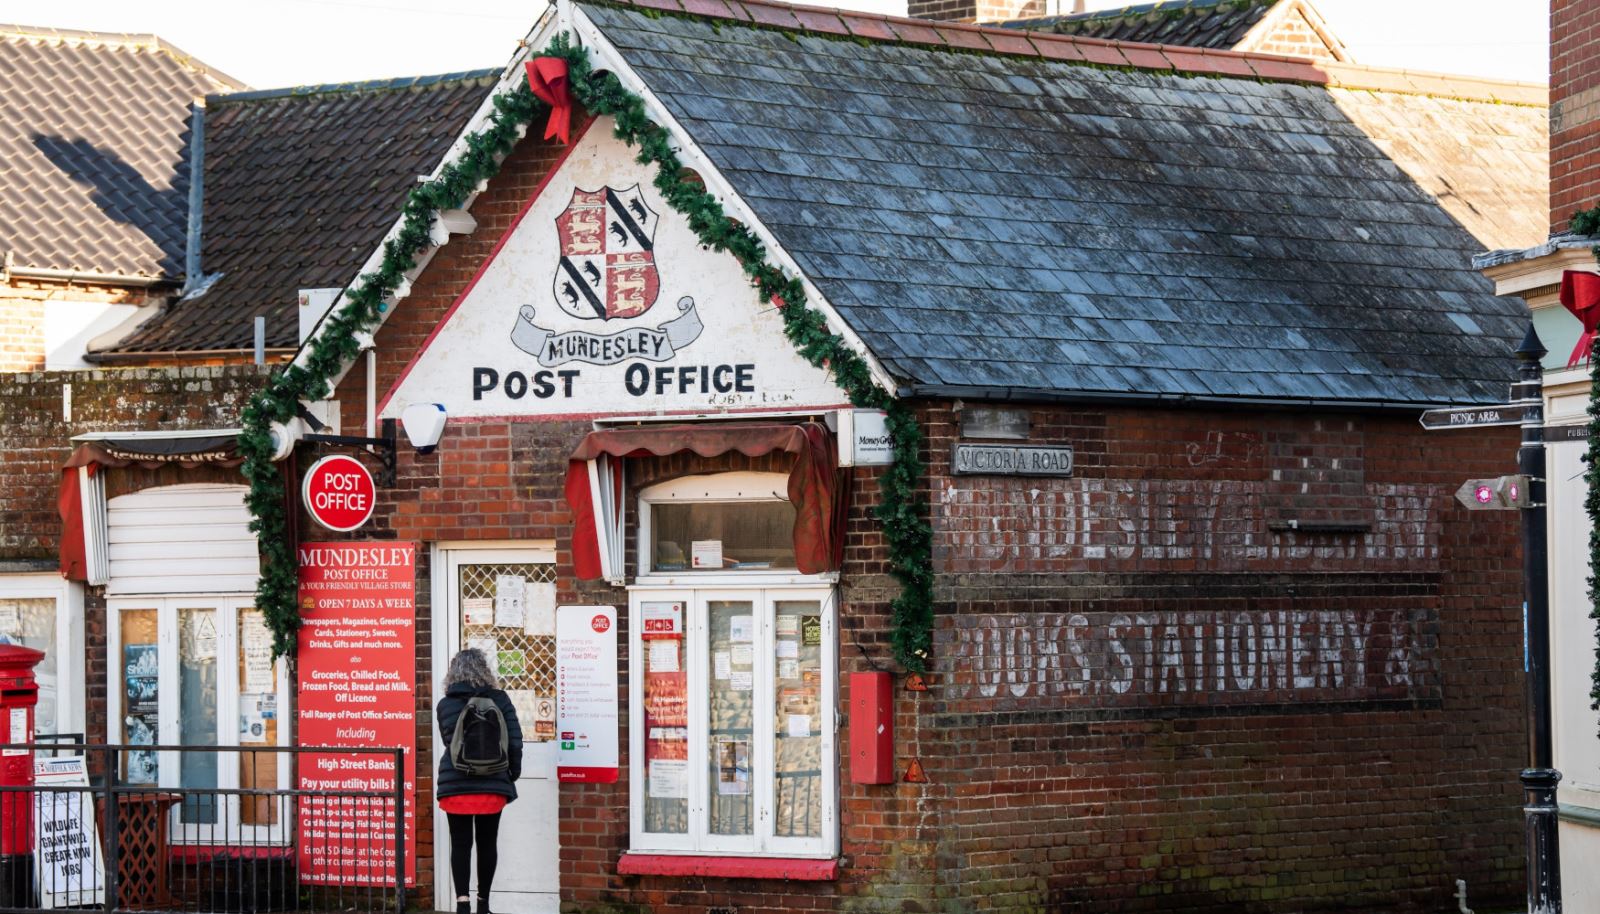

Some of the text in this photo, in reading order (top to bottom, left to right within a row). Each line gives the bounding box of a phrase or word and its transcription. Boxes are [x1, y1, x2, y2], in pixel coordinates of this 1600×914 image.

[549, 332, 664, 360] MUNDESLEY
[472, 362, 756, 401] POST OFFICE
[1451, 411, 1500, 424] PICNIC AREA
[961, 451, 1069, 470] VICTORIA ROAD
[316, 472, 366, 510] POST OFFICE
[300, 548, 414, 567] MUNDESLEY
[324, 569, 388, 579] POST OFFICE
[300, 582, 412, 590] & YOUR FRIENDLY VILLAGE STORE
[319, 599, 412, 608] OPEN 7 DAYS A WEEK
[301, 617, 412, 627] Newspapers, Magazines, Greetings
[315, 629, 397, 638] Cards, Stationery, Sweets,
[310, 641, 332, 649] Drinks,
[312, 670, 400, 680] Groceries, Chilled Food,
[302, 682, 411, 691] Frozen Food, Bread and Milk.
[335, 694, 377, 702] Off Licence
[301, 710, 412, 720] Full Range of Post Office Services
[336, 728, 376, 741] Including
[318, 759, 395, 771] High Street Banks
[301, 778, 412, 790] Pay your utility bills hre
[44, 818, 79, 832] WLDLFE
[61, 863, 81, 876] JBS
